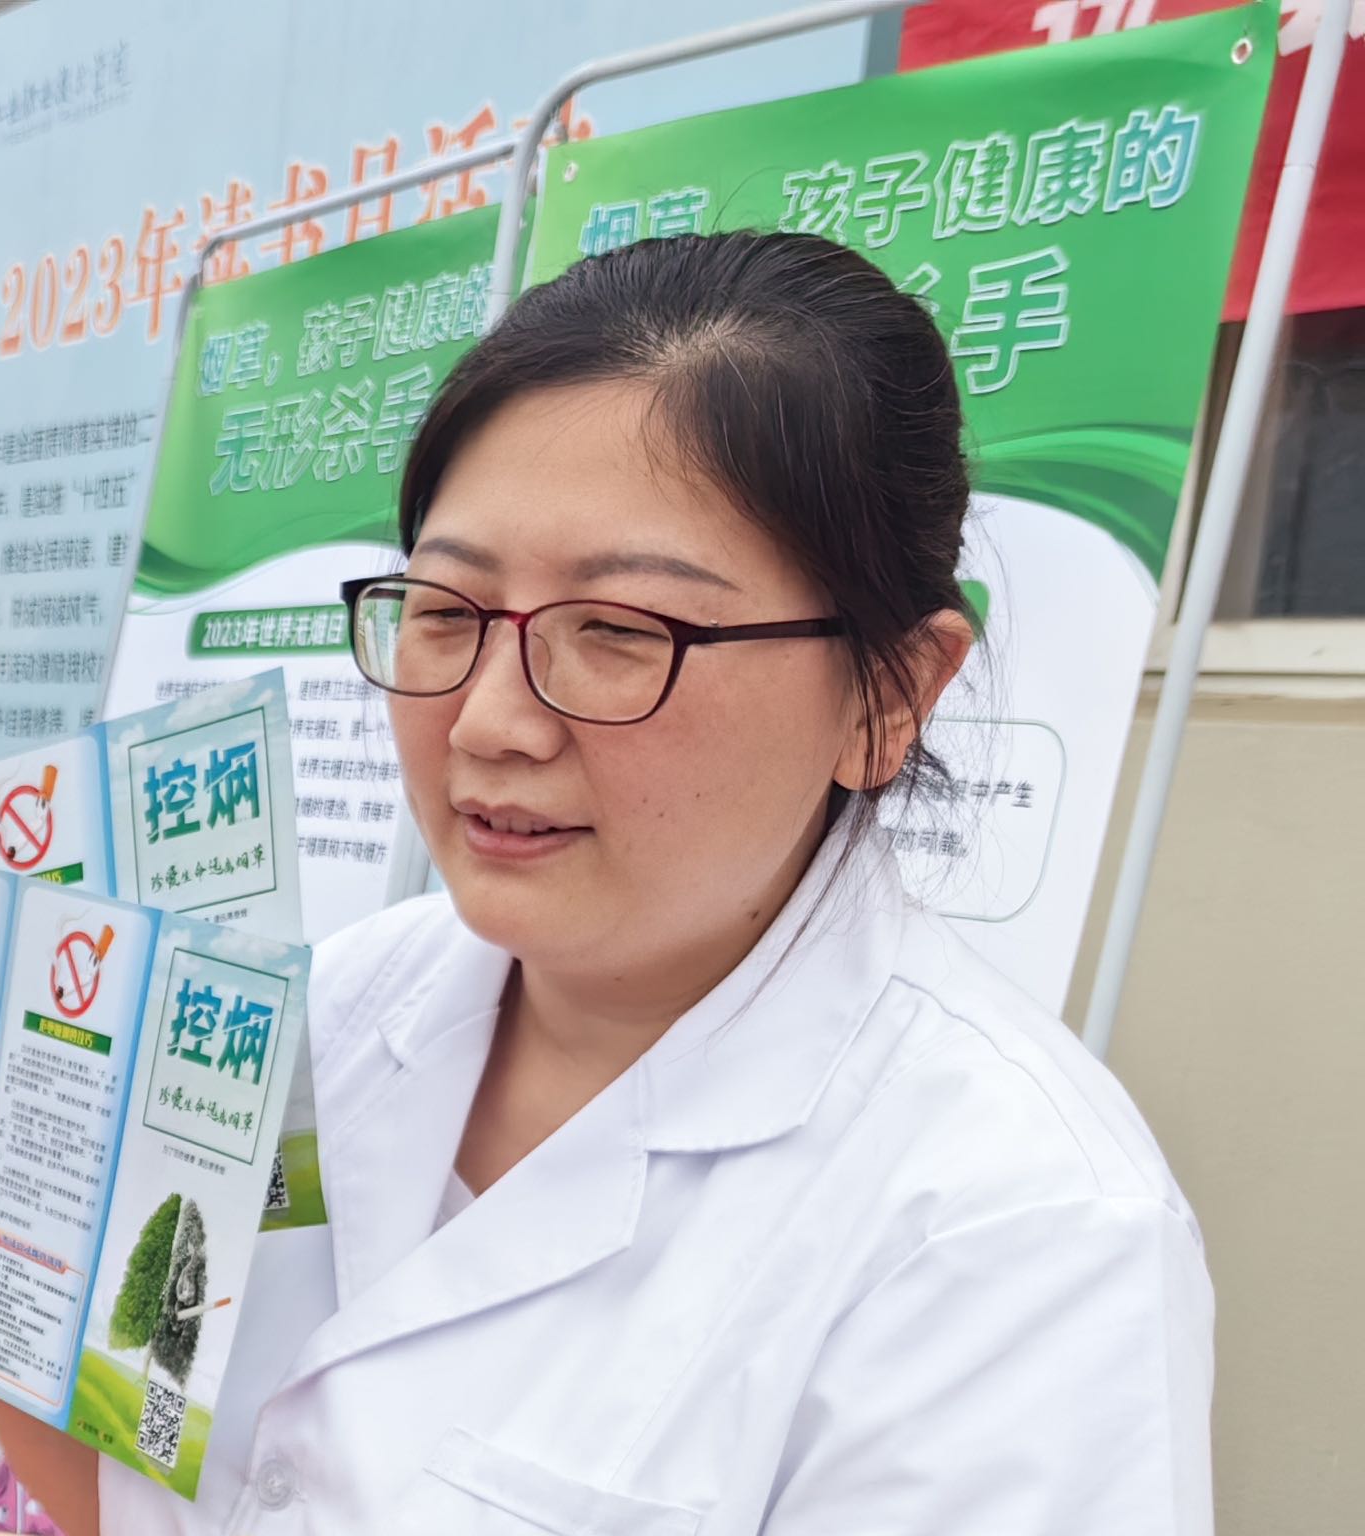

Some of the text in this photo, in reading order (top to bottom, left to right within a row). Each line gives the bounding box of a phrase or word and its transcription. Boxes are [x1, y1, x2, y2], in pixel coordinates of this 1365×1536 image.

[209, 362, 435, 496] 无形杀手
[201, 612, 346, 649] 2023年世界无烟日
[143, 741, 261, 845] 控烟
[168, 980, 274, 1084] 控烟
[158, 1086, 254, 1136] 珍爱生命远离烟草
